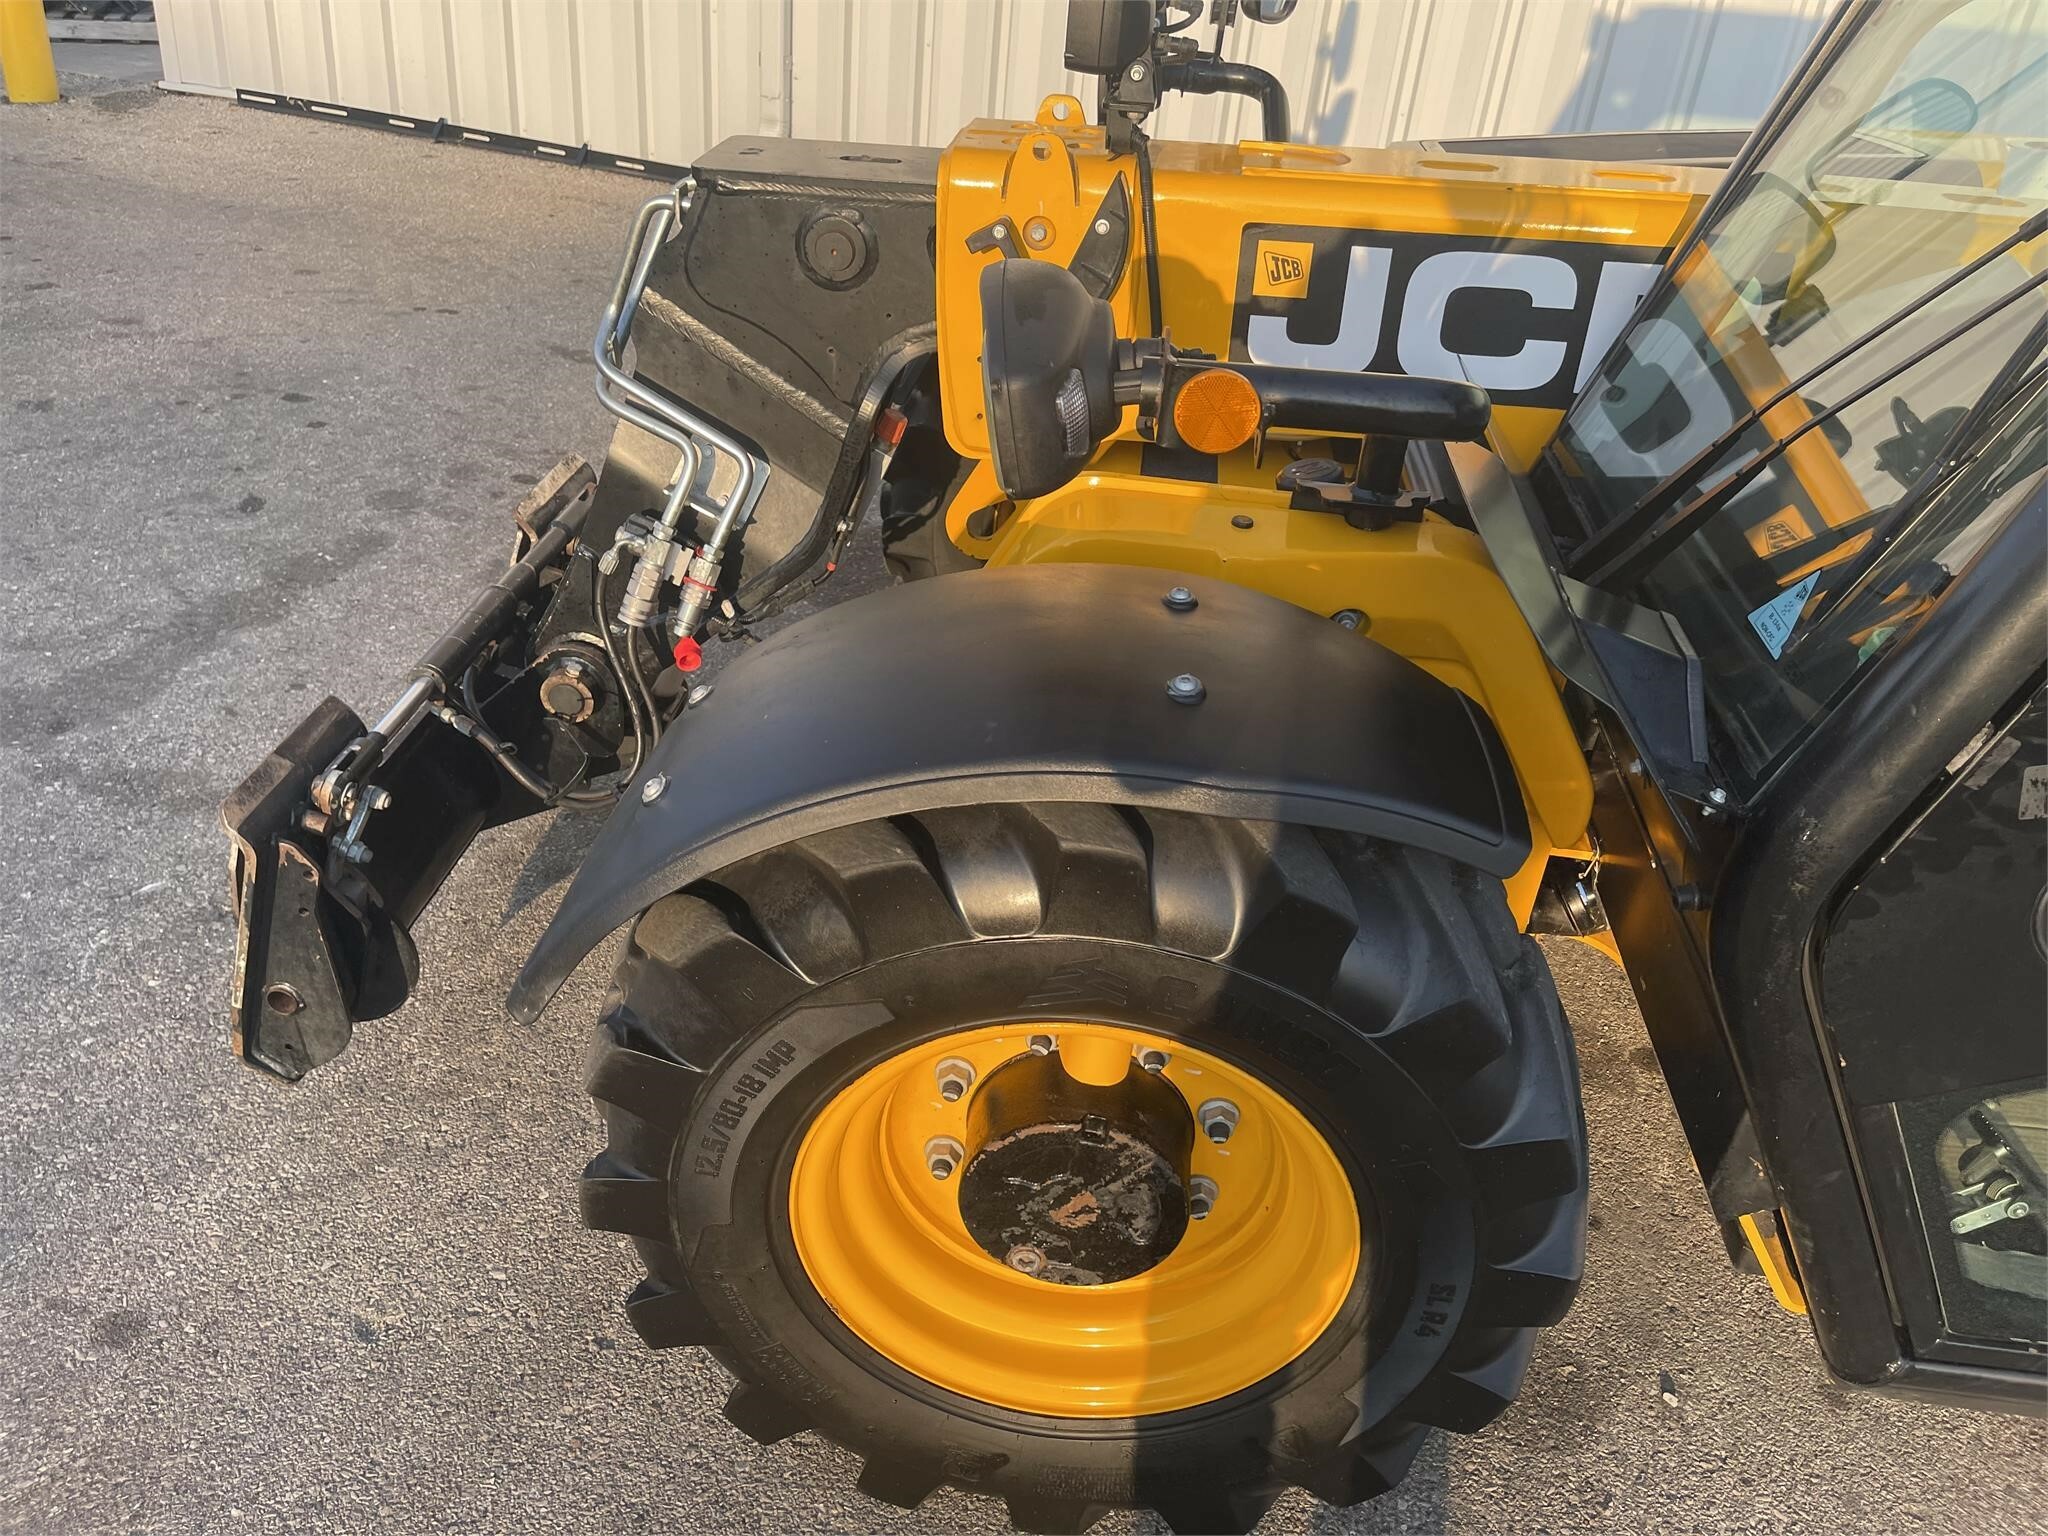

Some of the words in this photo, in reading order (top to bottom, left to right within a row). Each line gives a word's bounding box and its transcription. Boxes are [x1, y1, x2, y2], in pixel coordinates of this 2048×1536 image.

[1270, 255, 1301, 282] JCB
[695, 1073, 767, 1179] 12.5/80-18
[752, 1039, 797, 1079] IMP
